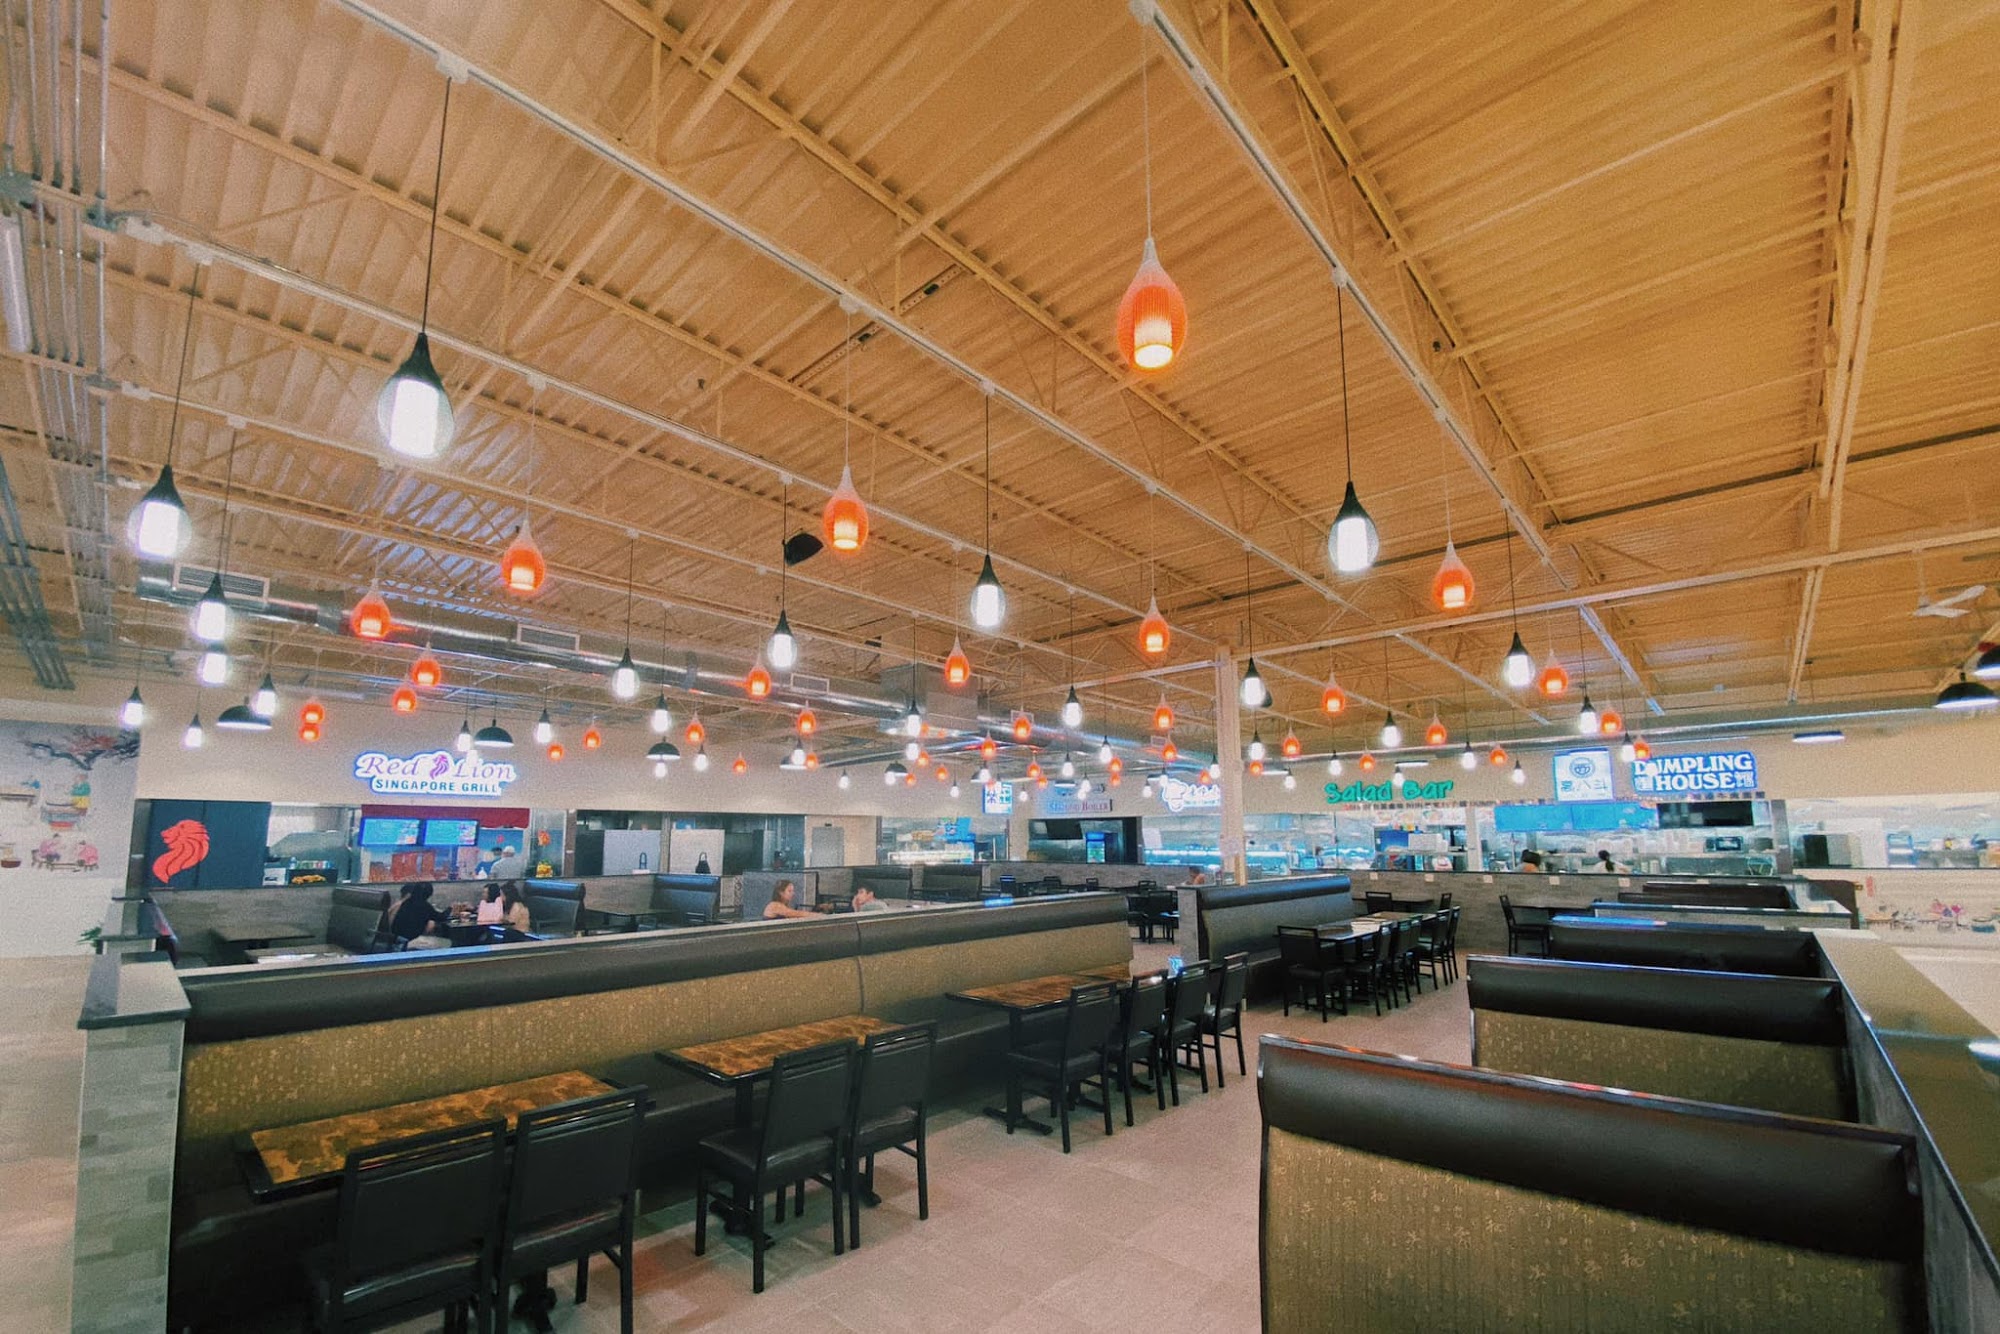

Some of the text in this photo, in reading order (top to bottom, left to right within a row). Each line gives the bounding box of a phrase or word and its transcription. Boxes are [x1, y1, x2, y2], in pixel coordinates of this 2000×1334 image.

[361, 755, 513, 779] Red Lion
[375, 779, 497, 793] SINGAPORE GRILL
[1655, 773, 1736, 790] HOUSE
[1324, 780, 1454, 804] Salad Bar
